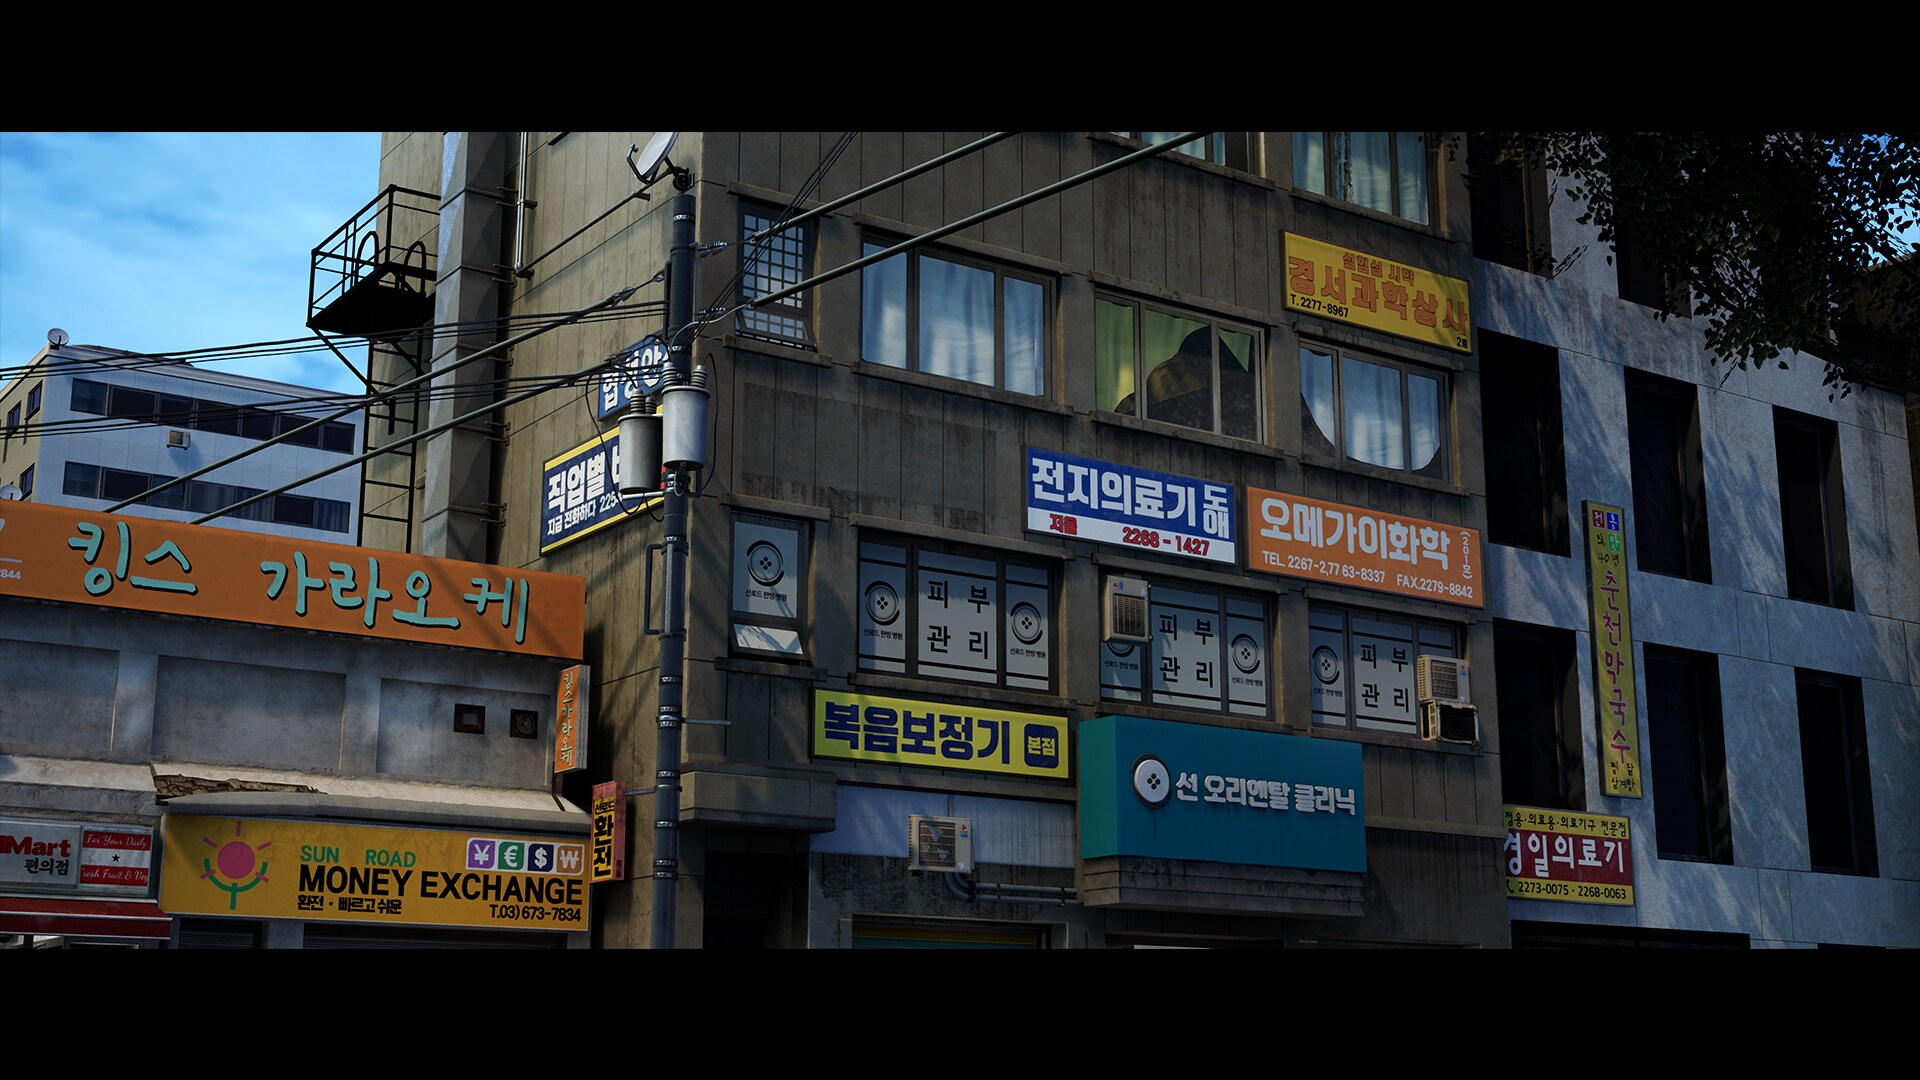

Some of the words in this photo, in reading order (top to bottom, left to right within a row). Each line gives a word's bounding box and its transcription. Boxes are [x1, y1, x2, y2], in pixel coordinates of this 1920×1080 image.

[1343, 252, 1383, 278] 실험실
[1388, 264, 1415, 286] 시약
[1289, 256, 1467, 336] 경서과학상사
[548, 451, 606, 513] 직업별
[1032, 457, 1196, 527] 전지의료기
[547, 514, 562, 536] 지금
[564, 499, 597, 530] 전화하다
[1260, 497, 1451, 571] 오메가이화학
[1459, 531, 1473, 579] (201호)
[68, 521, 199, 596] 킹스
[260, 551, 530, 644] 가라오케
[928, 580, 990, 613] 피부
[927, 625, 988, 659] 관리
[1159, 614, 1214, 645] 피부
[1160, 656, 1213, 688] 관리
[1361, 644, 1408, 672] 피부
[1600, 570, 1631, 765] 춘천막국수
[1362, 683, 1409, 713] 관리
[824, 701, 1010, 765] 복음보정기
[1027, 736, 1056, 757] 본점
[595, 800, 614, 815] 선로드
[1176, 771, 1199, 802] 선
[1204, 775, 1290, 811] 오리엔탈
[1294, 783, 1356, 816] 클리닉
[86, 833, 101, 844] For
[103, 835, 124, 846] Your
[125, 836, 147, 848] Daily
[300, 846, 340, 864] SUN
[365, 849, 417, 868] ROAD
[594, 814, 614, 877] 환전
[24, 857, 70, 875] 편의점
[81, 867, 100, 878] resh
[102, 869, 123, 880] Fruit
[298, 864, 413, 896] MONEY
[420, 870, 584, 905] EXCHANGE
[1518, 882, 1569, 896] 2273-0075
[1577, 885, 1627, 900] 2268-0063
[297, 894, 324, 911] 환전
[337, 898, 376, 914] 빠르고
[377, 899, 402, 915] 쉬운
